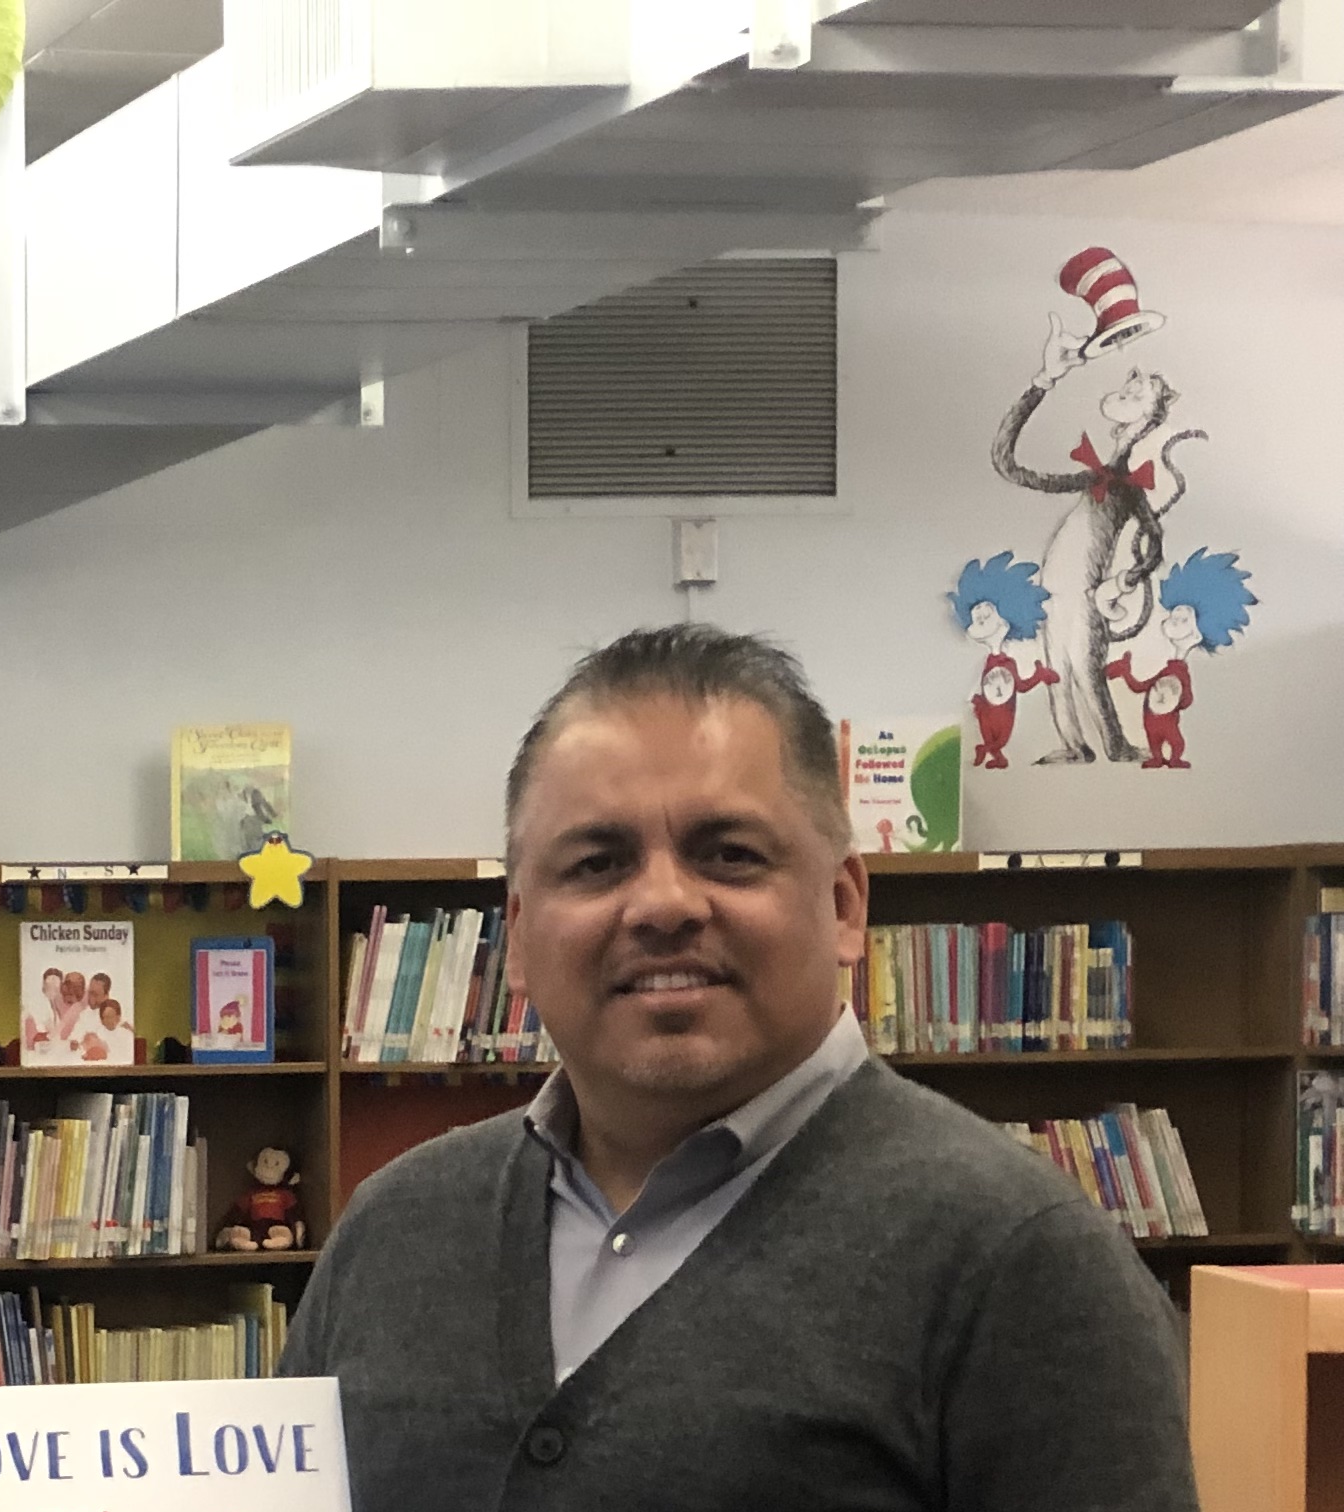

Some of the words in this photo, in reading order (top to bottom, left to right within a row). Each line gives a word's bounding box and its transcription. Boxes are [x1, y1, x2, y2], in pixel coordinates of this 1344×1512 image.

[878, 730, 894, 740] An
[30, 924, 80, 942] Chicken
[83, 924, 128, 945] Sunday
